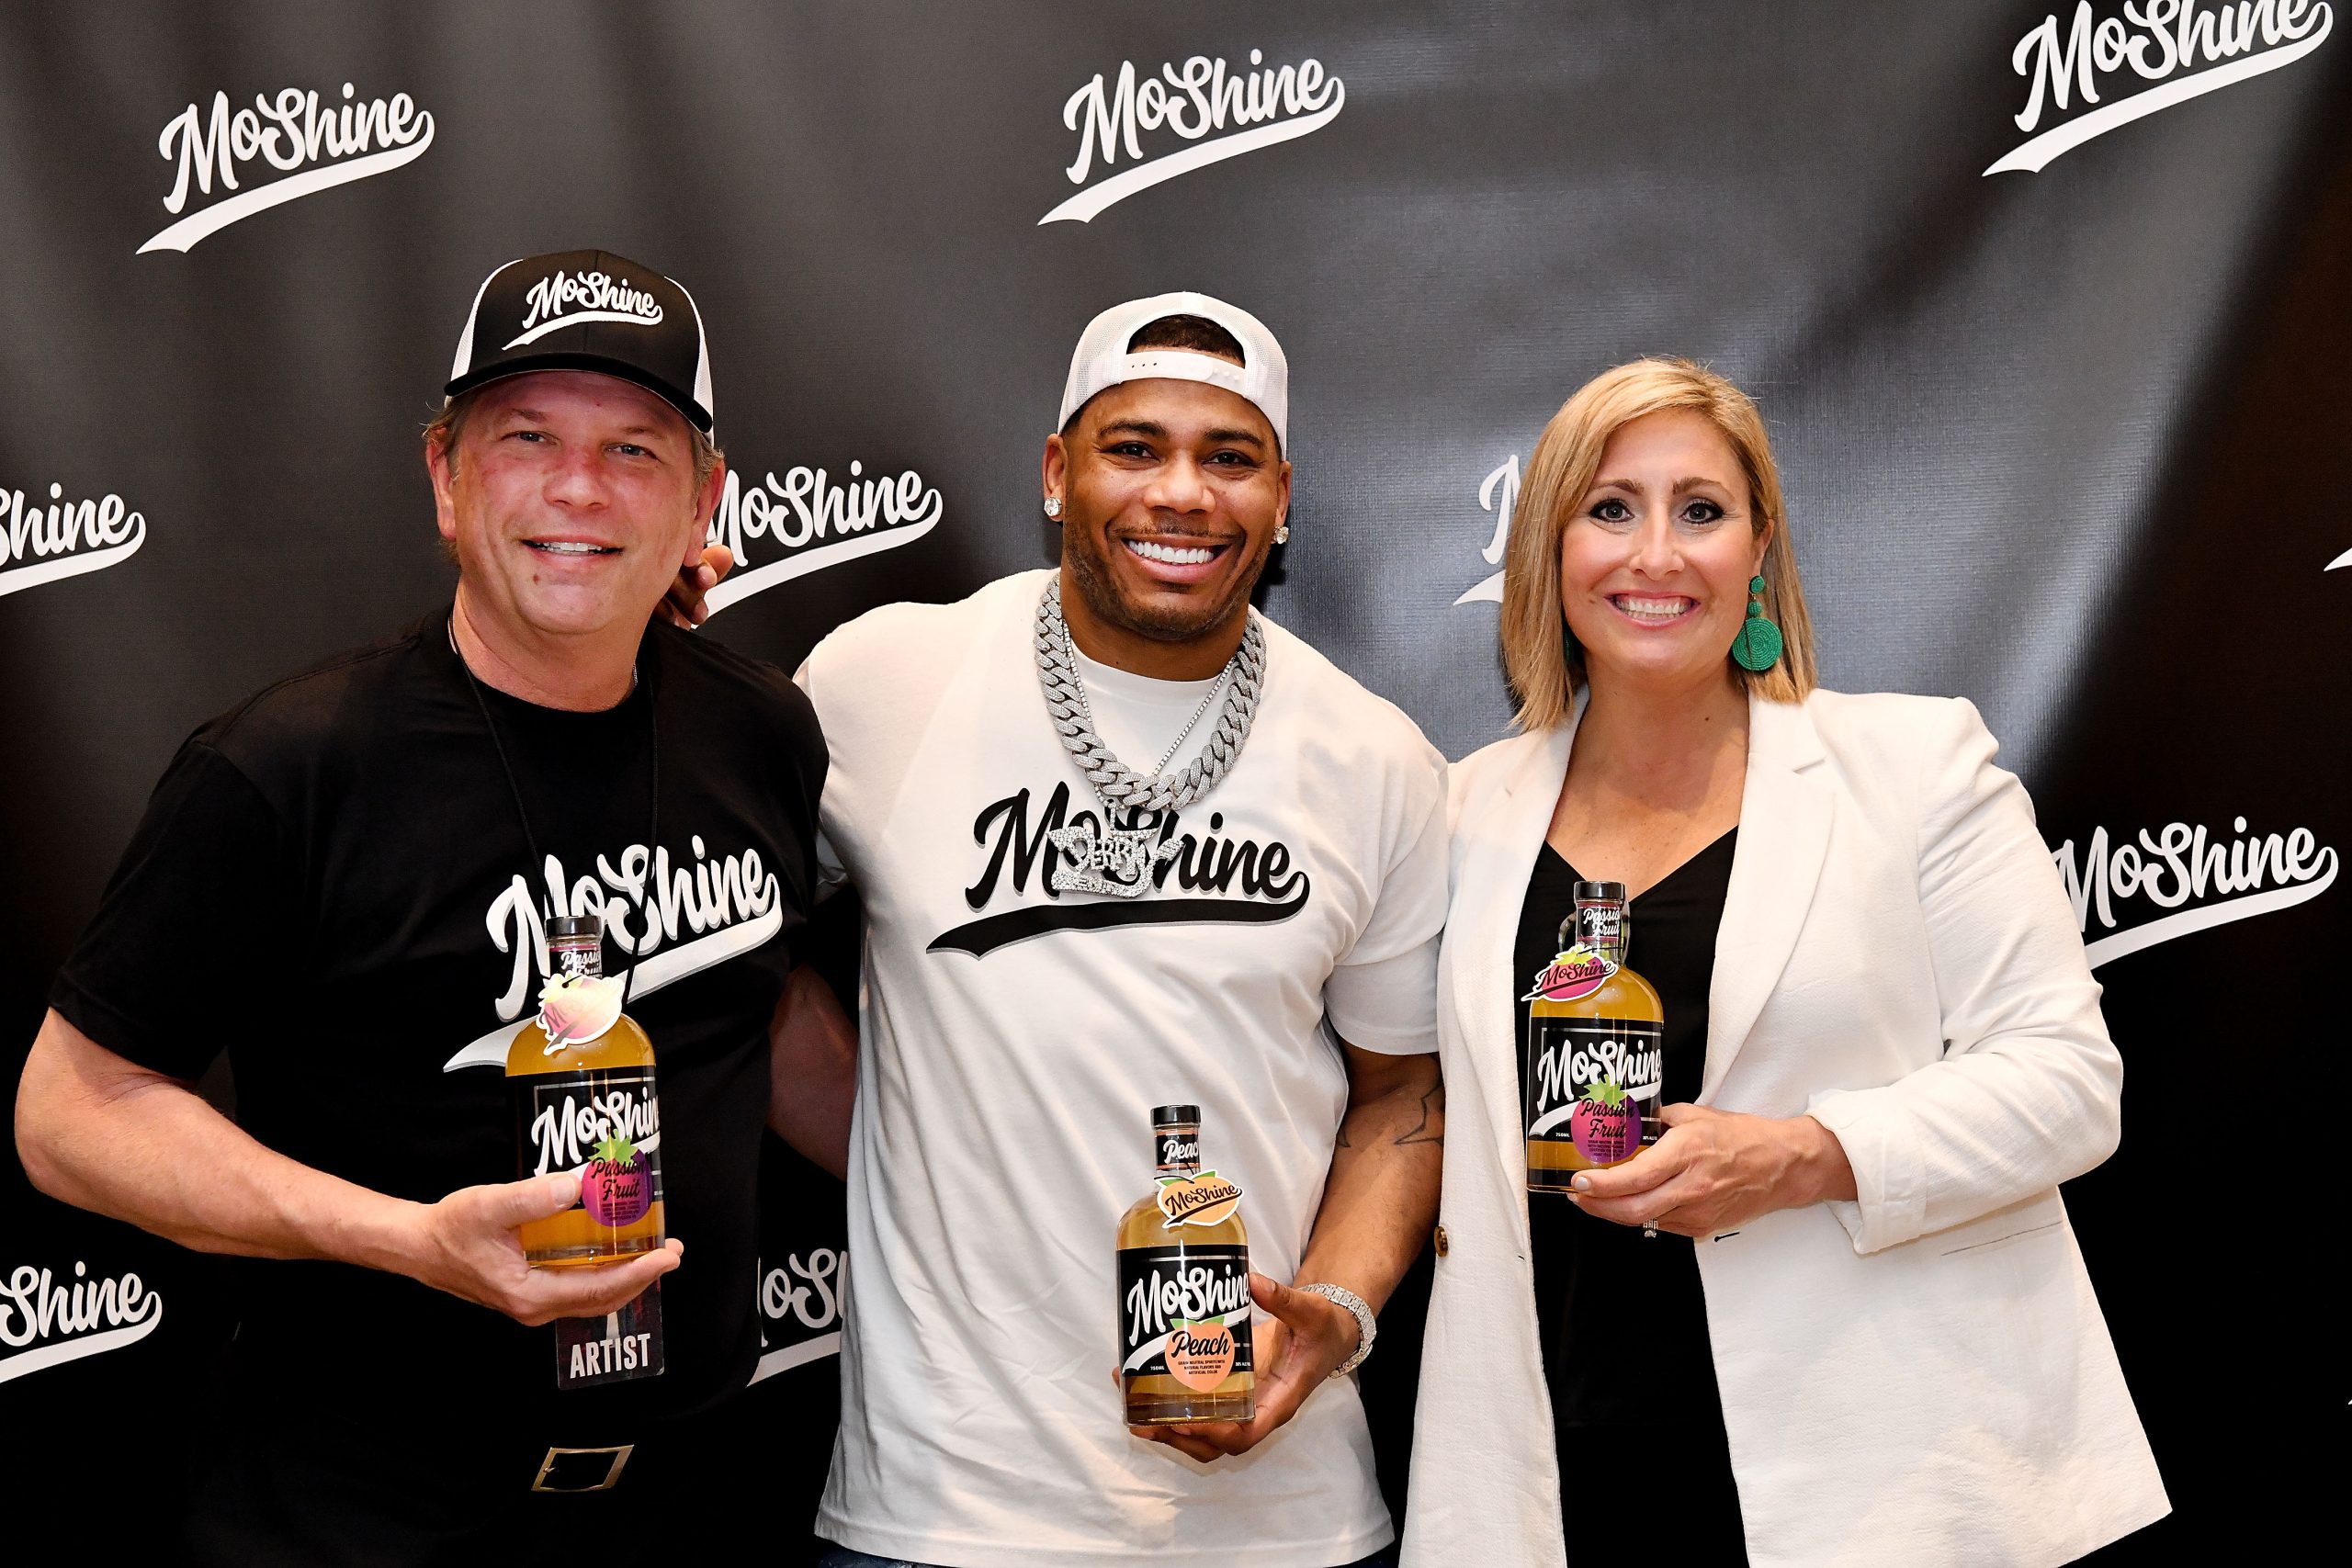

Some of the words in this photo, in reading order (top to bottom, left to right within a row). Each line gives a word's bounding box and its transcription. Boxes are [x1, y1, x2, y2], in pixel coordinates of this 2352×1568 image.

[2012, 0, 2334, 132] MoShine
[1063, 49, 1346, 185] MoShine
[158, 82, 435, 215] MoShine
[522, 270, 663, 329] MoShine
[0, 481, 147, 568] hine
[2051, 816, 2339, 933] MoShine
[1537, 962, 1618, 989] MoShine
[1537, 1039, 1662, 1113] MoShine
[1580, 1098, 1635, 1118] Passion
[1589, 1118, 1627, 1138] Fruit
[591, 1156, 645, 1179] Passion
[602, 1179, 640, 1201] Fruit
[1165, 1184, 1243, 1216] MoShine
[1127, 1264, 1250, 1347] MoShine
[570, 1333, 650, 1379] ARTIST
[1170, 1330, 1230, 1359] Peach
